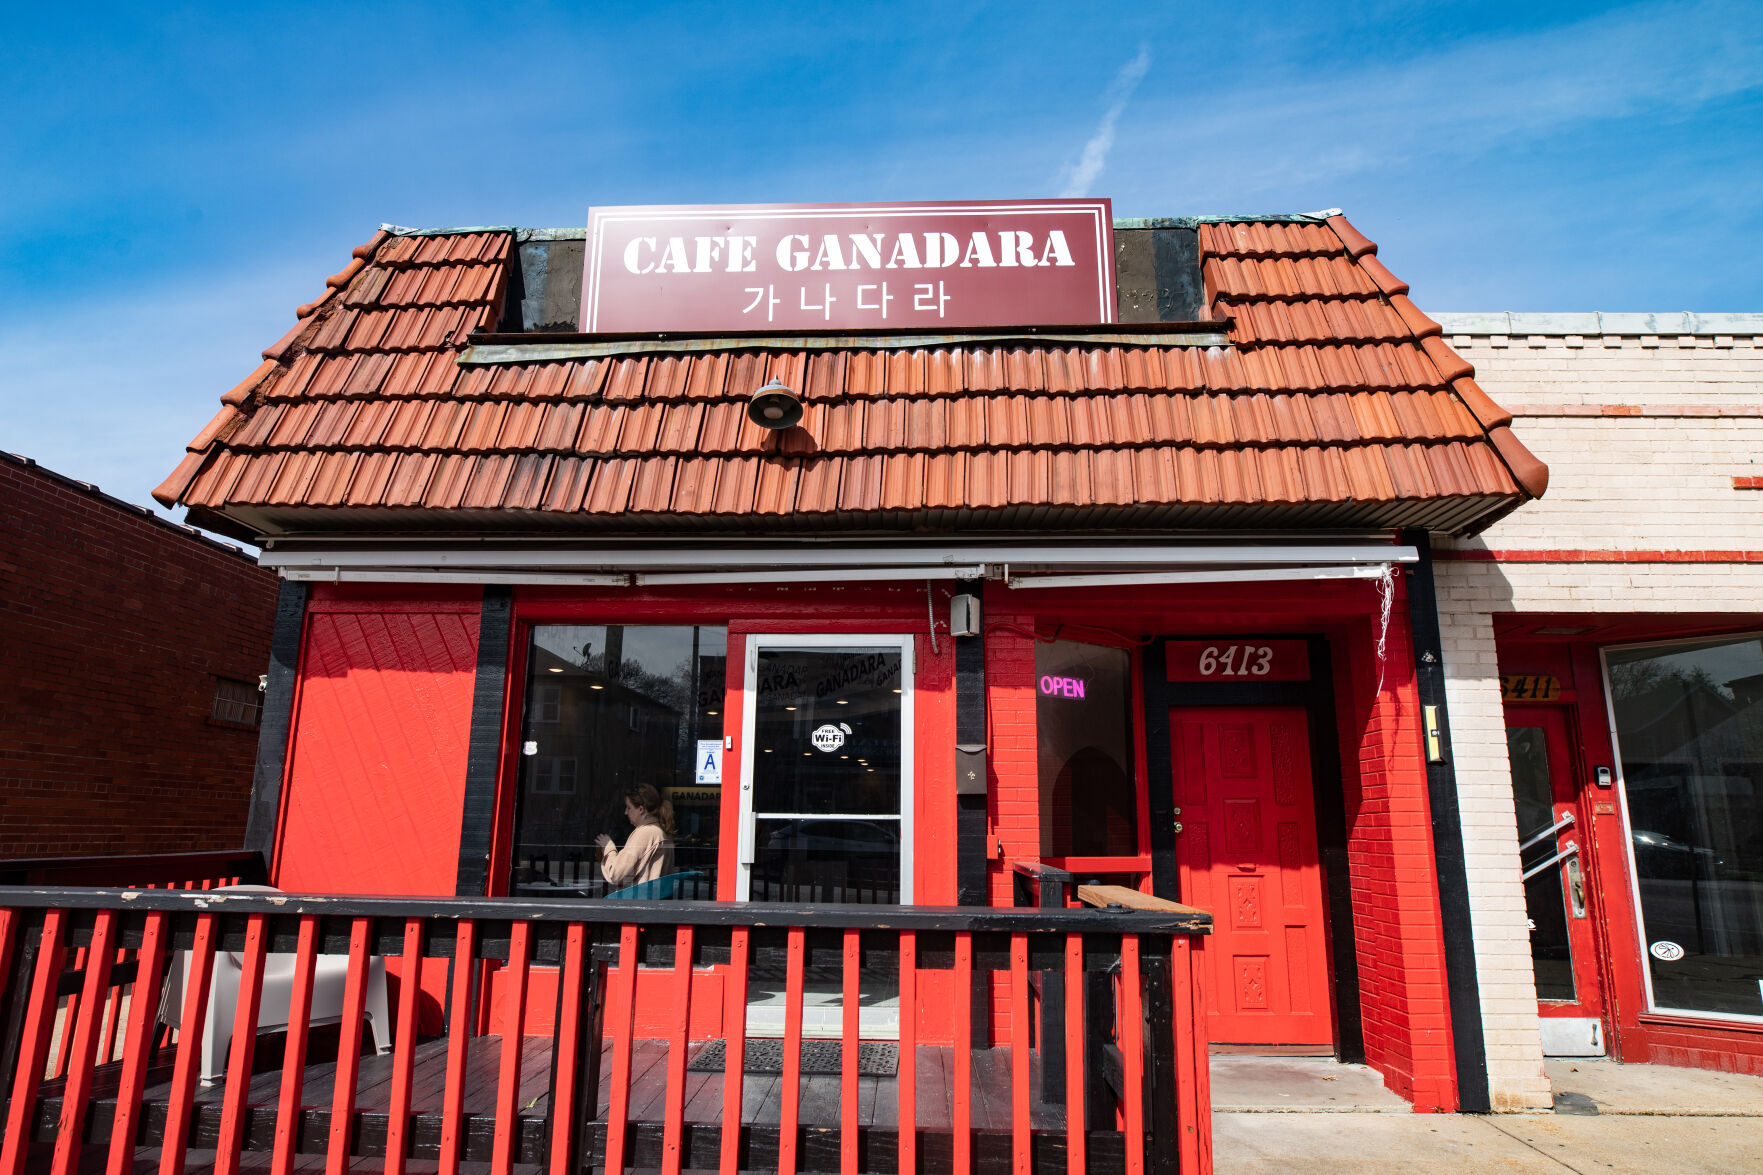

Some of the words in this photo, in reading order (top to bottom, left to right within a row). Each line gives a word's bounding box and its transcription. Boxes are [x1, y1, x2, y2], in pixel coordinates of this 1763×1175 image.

[623, 235, 757, 275] CAFE
[775, 229, 1076, 273] GANADARA
[1199, 645, 1273, 676] 6413
[816, 652, 886, 698] GANADARA
[1040, 675, 1085, 698] OPEN
[814, 734, 842, 743] Wi-Fi
[703, 753, 716, 770] A
[671, 791, 721, 801] GANADAR
